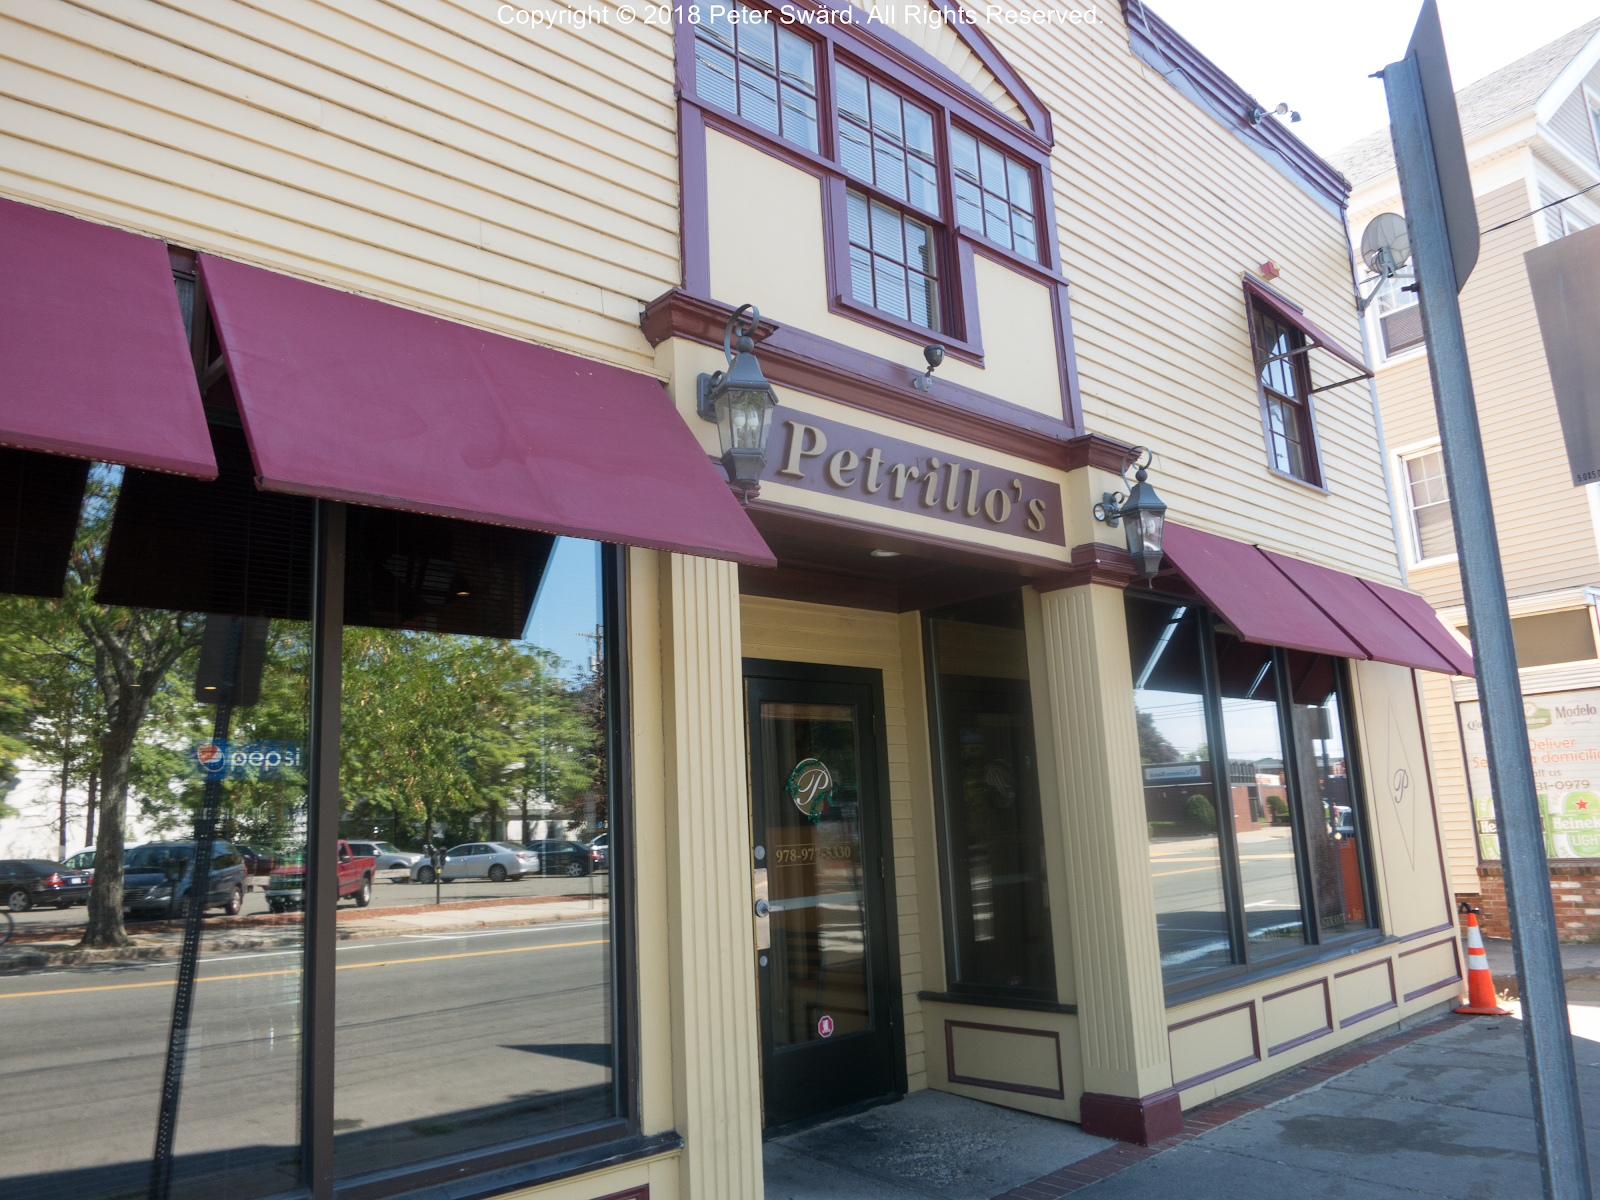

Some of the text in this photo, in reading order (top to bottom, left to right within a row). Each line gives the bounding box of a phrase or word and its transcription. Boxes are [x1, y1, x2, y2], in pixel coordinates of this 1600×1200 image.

[1555, 704, 1597, 719] Modelo
[1528, 737, 1577, 751] Deliver
[230, 747, 300, 771] pepsi
[1533, 769, 1562, 777] all us
[1535, 780, 1590, 791] 31-0979
[1552, 816, 1600, 829] Heinek
